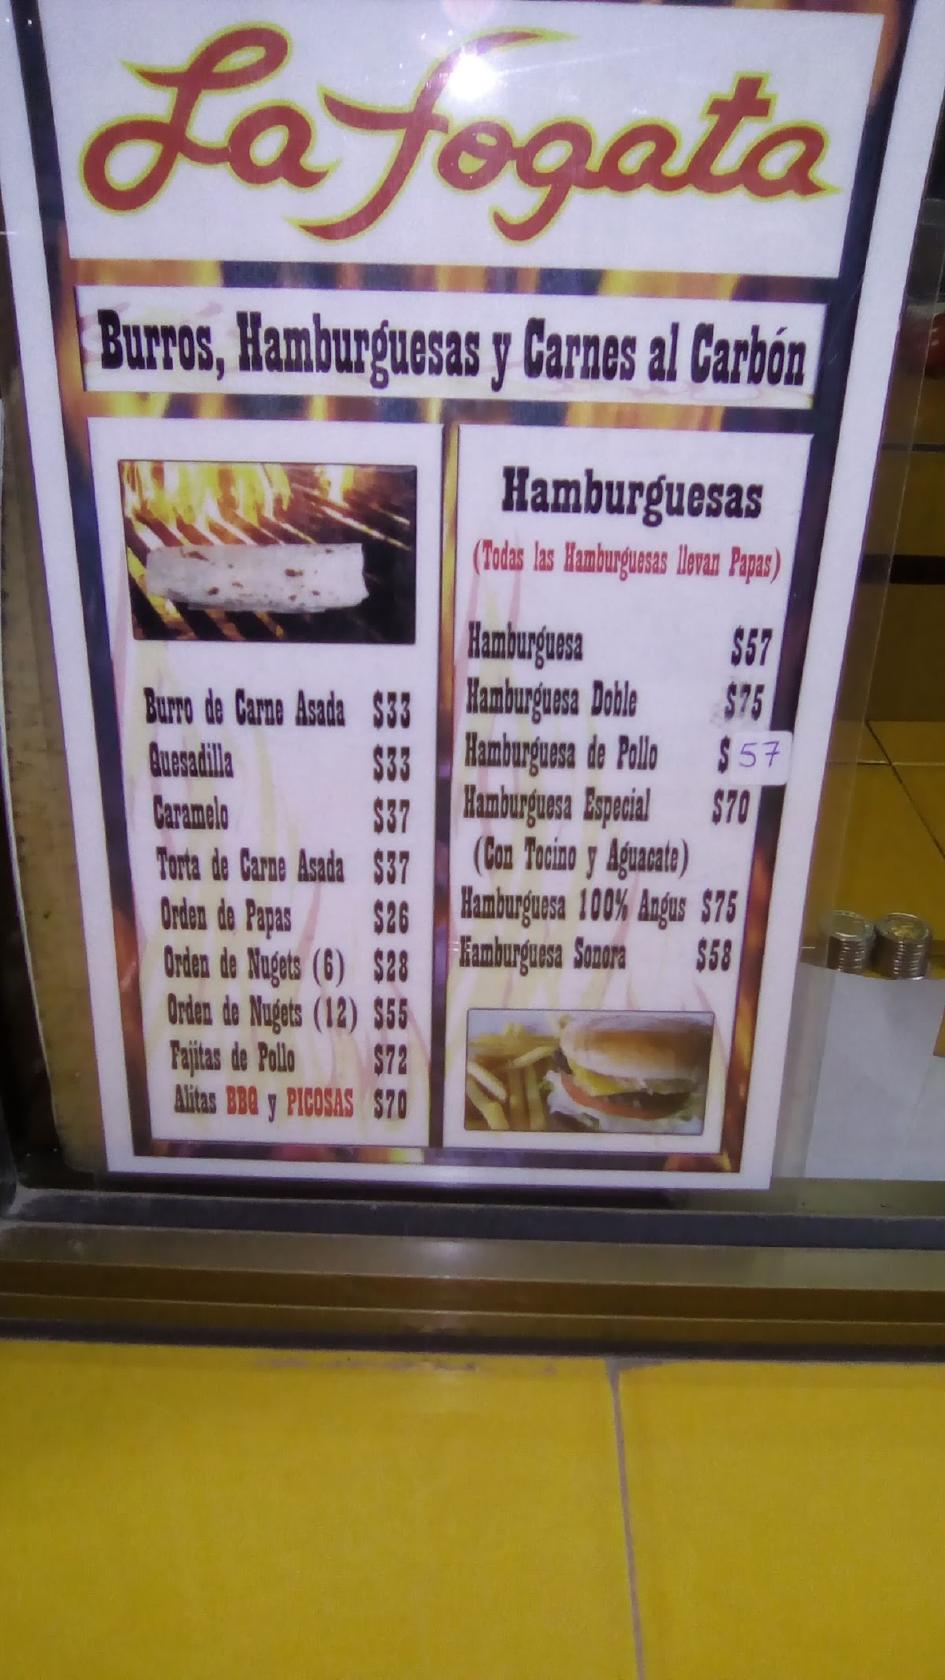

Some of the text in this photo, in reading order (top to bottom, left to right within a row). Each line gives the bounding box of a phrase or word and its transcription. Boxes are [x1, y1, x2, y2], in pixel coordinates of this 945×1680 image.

[78, 22, 329, 212] La
[97, 309, 805, 391] Burros, Hamburguesas y Carnes al Carbón
[502, 465, 764, 527] Hamburguesas
[473, 538, 781, 584] (Todas las Hamburguesas llevan Papas)
[468, 621, 772, 669] Hamburguesa $57
[143, 687, 411, 729] Burro de Carne Asada $33
[466, 677, 764, 723] Hamburguesa Doble $75
[149, 742, 411, 783] Quesadilla $33
[464, 733, 730, 776] Hamburguesa de Pollo $
[739, 740, 781, 768] 57
[153, 795, 410, 834] Caramelo $37
[463, 784, 750, 828] Hamburguesa Especial $70
[156, 846, 410, 885] Torta de Carne Asada $37
[473, 836, 689, 880] (Con Tocino y Aguacate)
[161, 896, 410, 940] Orden de Papas $26
[461, 886, 738, 930] Hamburguesa 100% Angus $75
[164, 945, 409, 988] Orden de Nugets (6) $28
[459, 935, 732, 976] Hamburguesa Sonora $58
[168, 993, 408, 1035] Orden de Nugets (12) $55
[170, 1039, 407, 1078] Fajitas de Pollo $72
[174, 1084, 407, 1122] Alitas BBQ y PICOSAS $70
